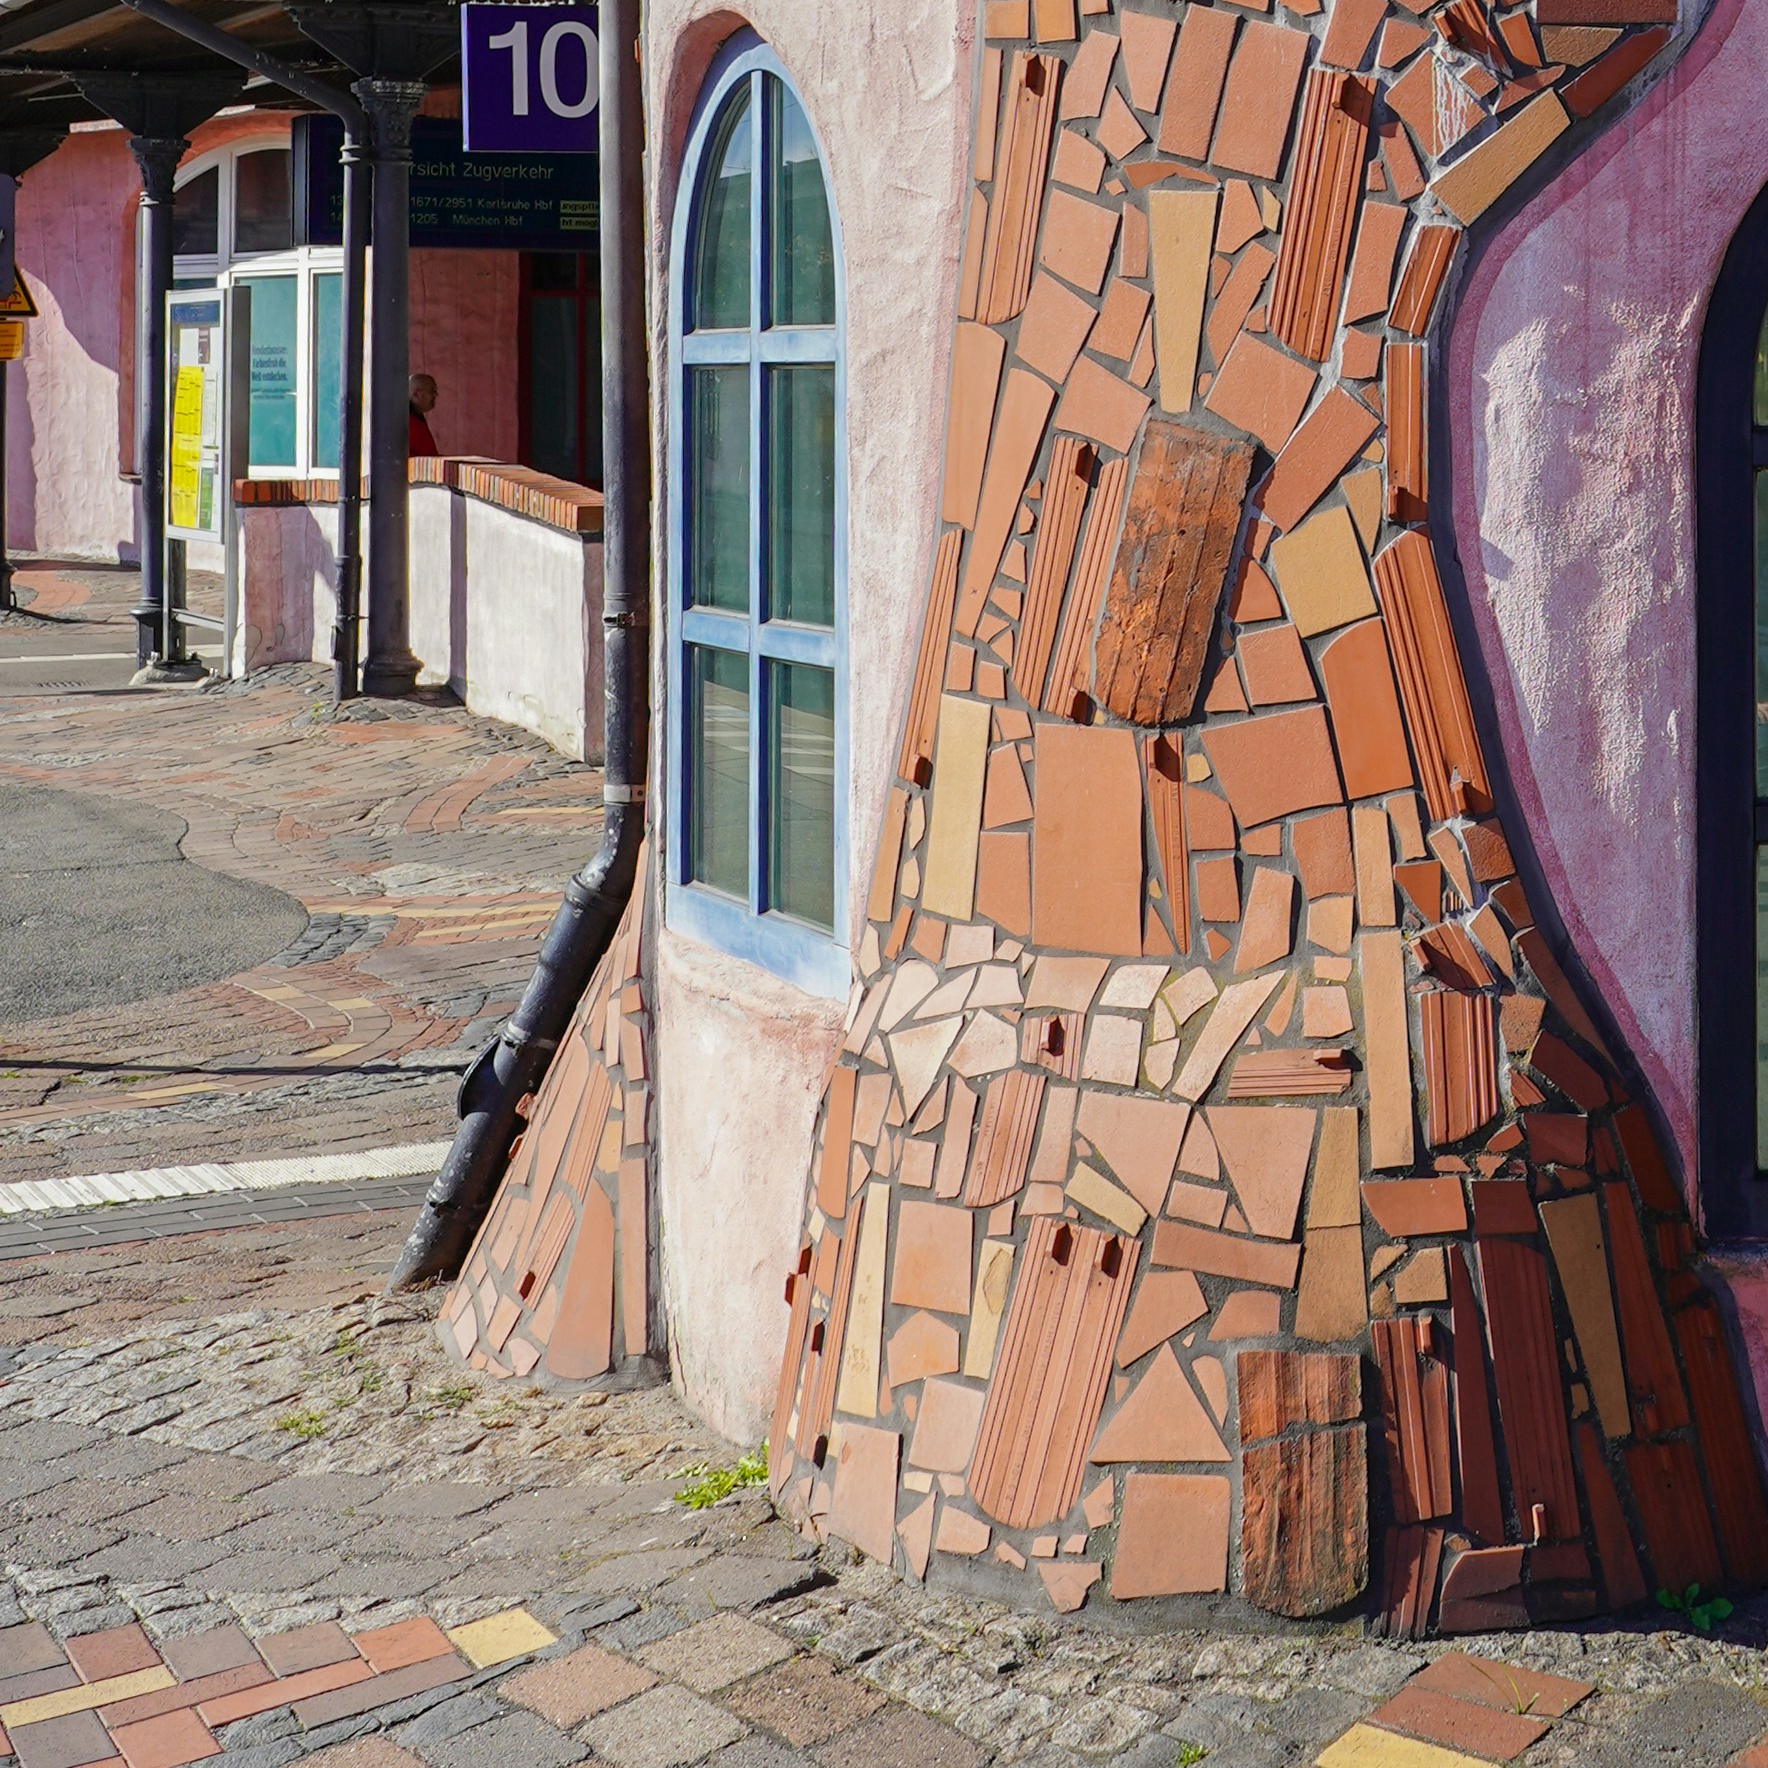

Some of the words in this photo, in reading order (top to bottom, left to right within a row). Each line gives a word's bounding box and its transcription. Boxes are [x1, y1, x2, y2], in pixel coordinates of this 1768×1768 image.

[488, 20, 599, 119] 10
[462, 162, 554, 181] Zugverkehr
[477, 198, 531, 211] Karlsruhe
[534, 199, 553, 211] Hbf
[410, 213, 439, 224] 1205
[452, 213, 500, 225] München
[504, 215, 523, 226] Hbf
